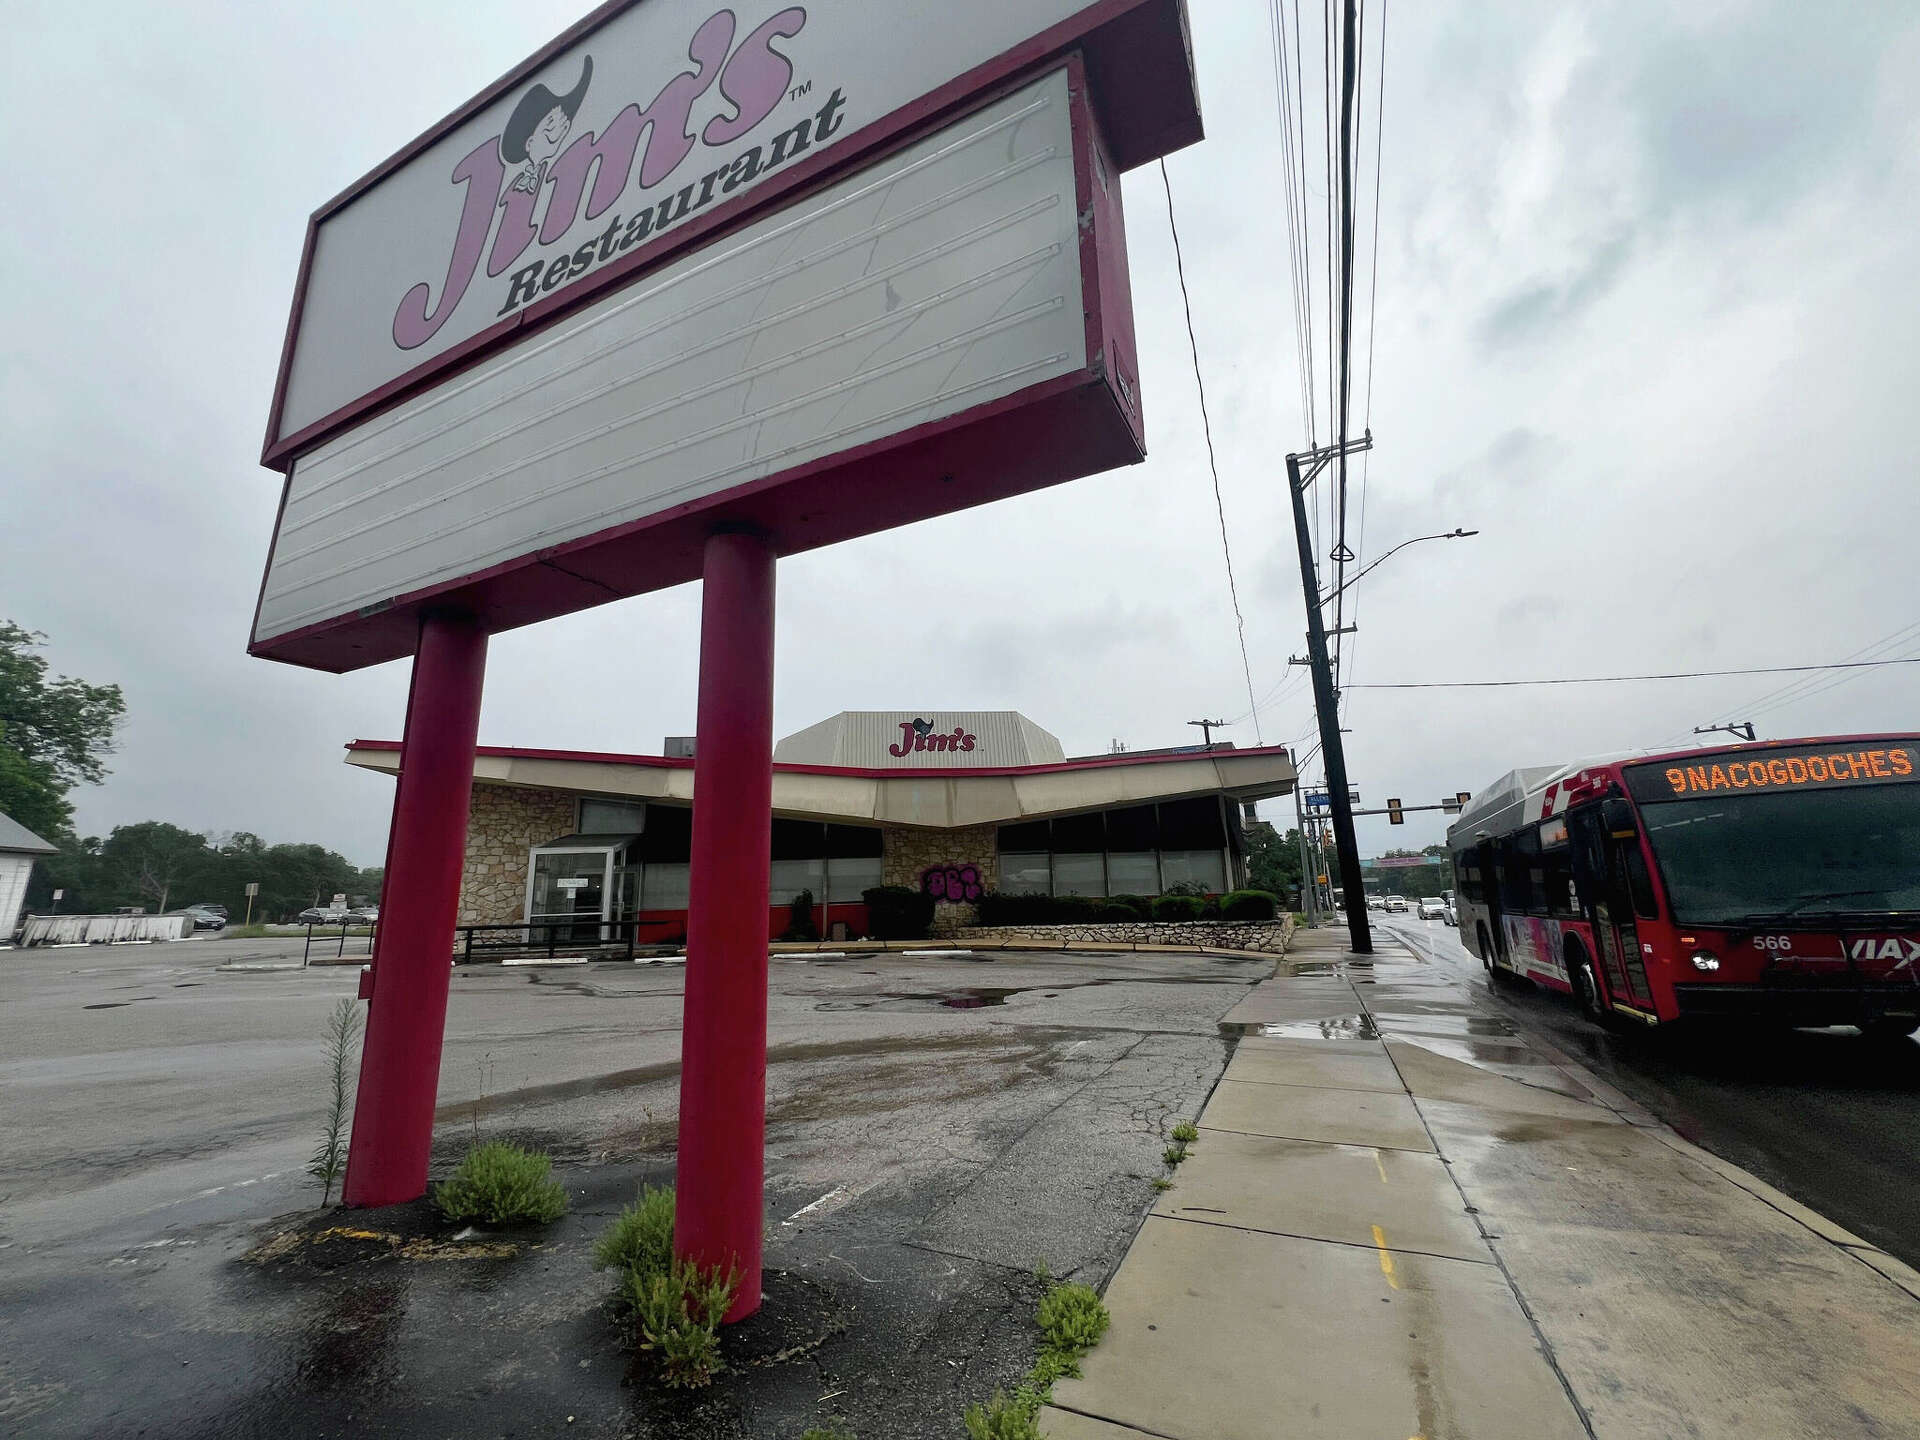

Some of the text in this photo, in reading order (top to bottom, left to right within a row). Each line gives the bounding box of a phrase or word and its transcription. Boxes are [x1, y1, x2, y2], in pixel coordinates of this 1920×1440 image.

[392, 6, 807, 350] Jim's
[497, 87, 847, 317] Restaurant
[888, 722, 977, 757] Jim's
[1753, 935, 1792, 950] 566
